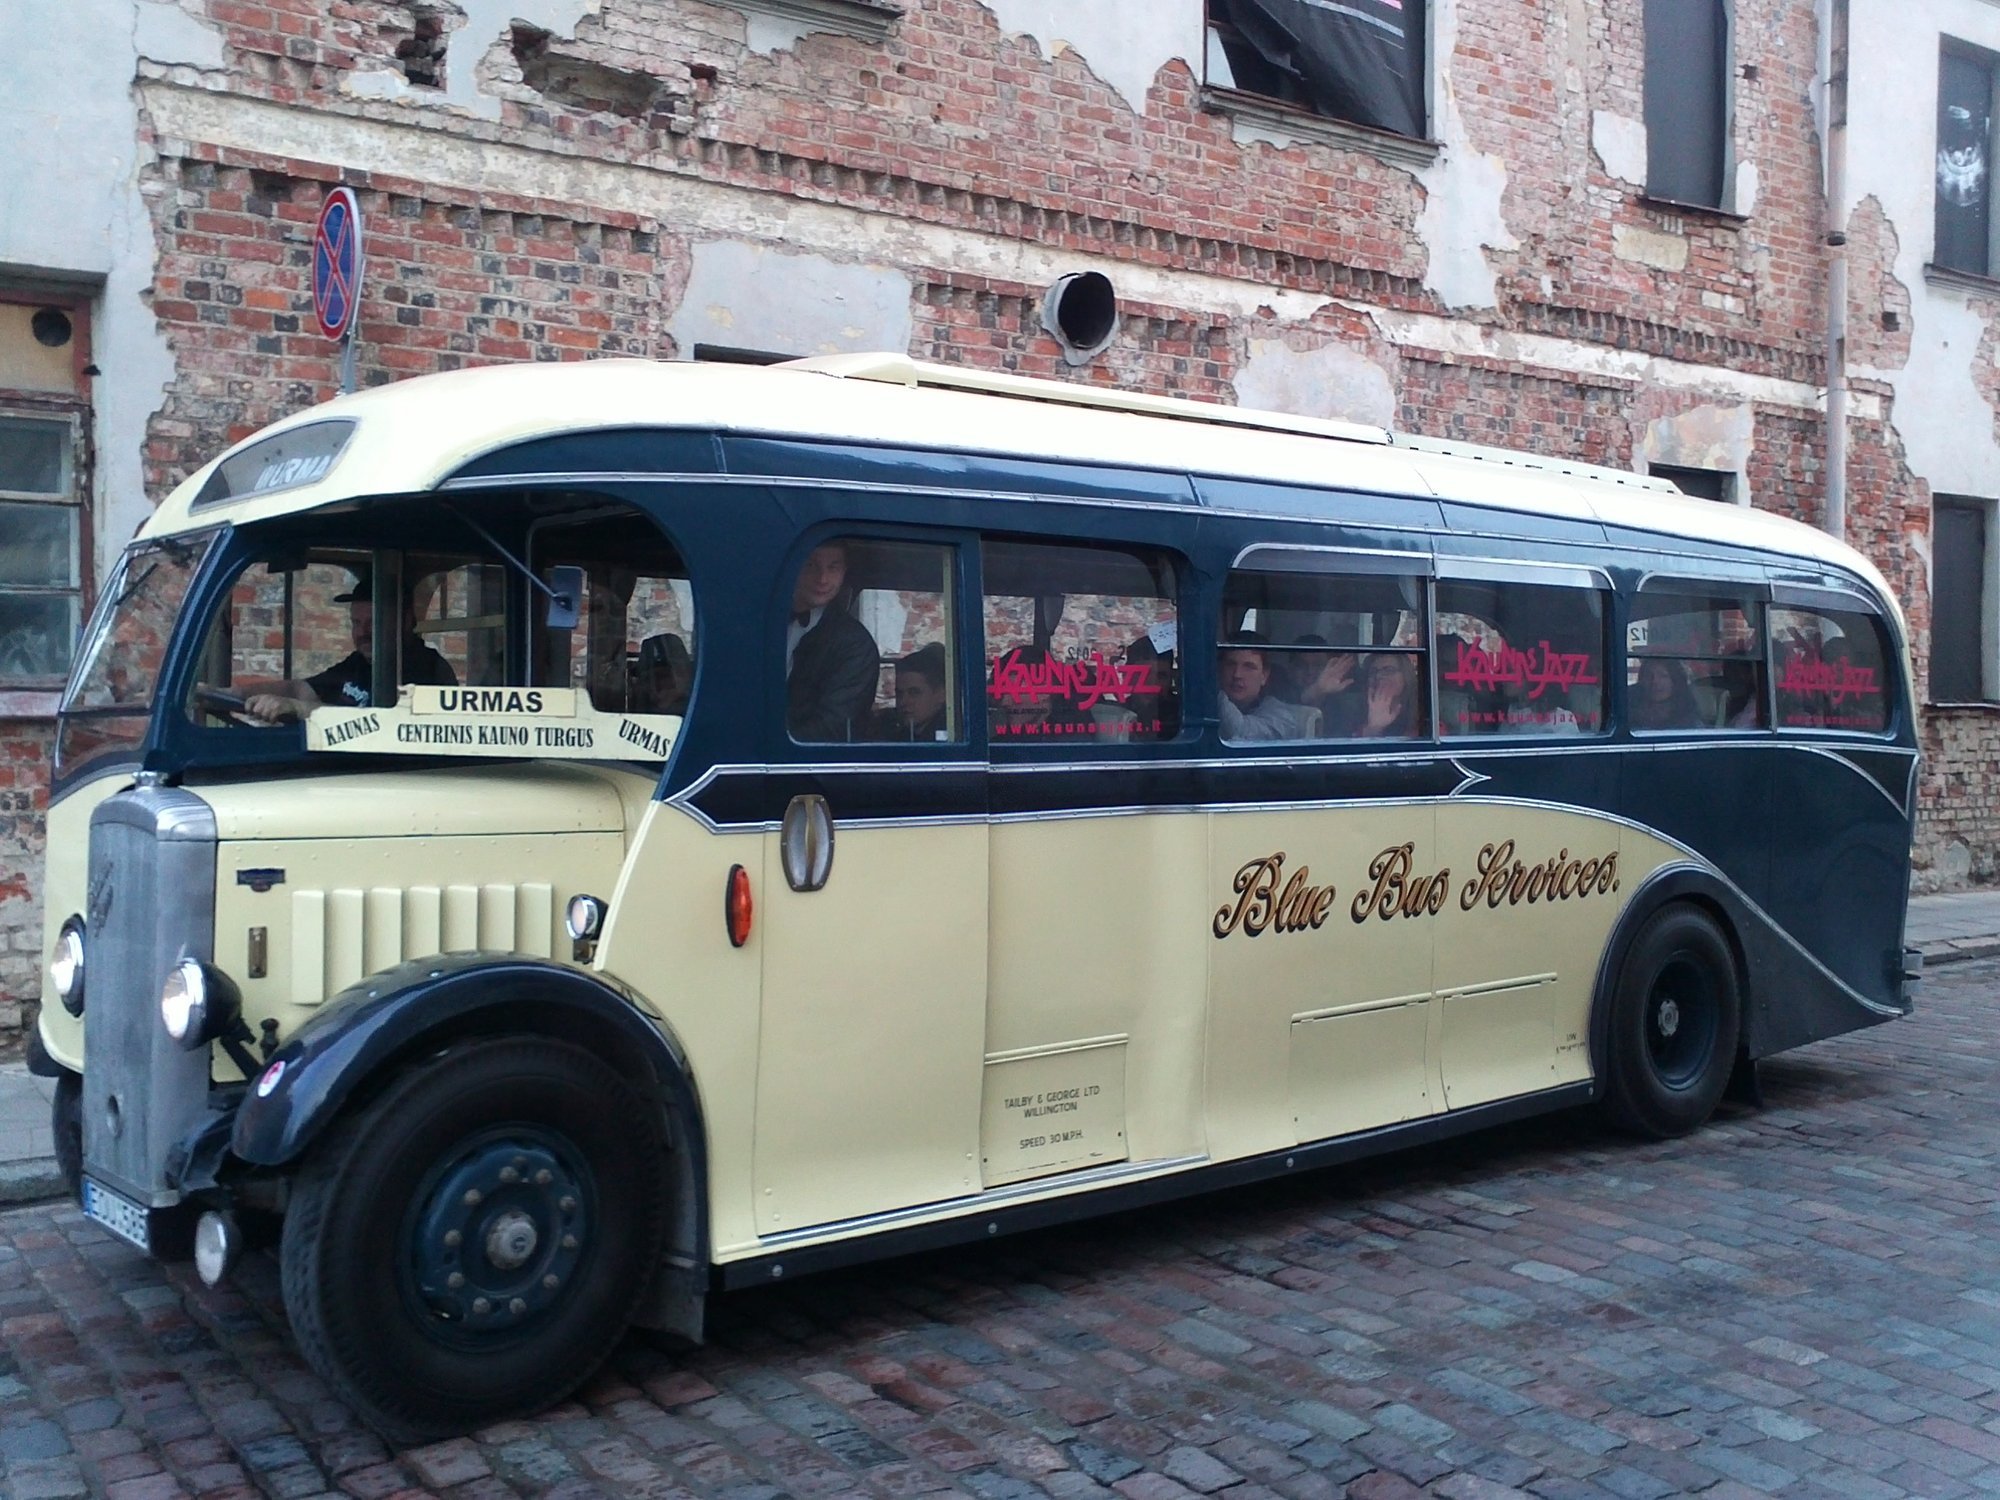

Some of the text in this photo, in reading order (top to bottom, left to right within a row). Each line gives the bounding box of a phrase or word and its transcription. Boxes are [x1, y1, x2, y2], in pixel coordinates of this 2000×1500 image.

[1078, 651, 1161, 711] JAZZ
[1528, 640, 1598, 699] JAZZ
[439, 689, 543, 713] URMAS
[324, 713, 381, 747] KAUNAS
[397, 723, 594, 748] CENTRINIS KAUNO TURGUS
[618, 718, 671, 758] URMAS
[1213, 851, 1337, 939] Blue
[1351, 841, 1450, 924] Bus
[1004, 1095, 1033, 1109] TAILBY
[1046, 1088, 1080, 1103] GEORGE
[1084, 1085, 1101, 1097] LTD
[1024, 1102, 1077, 1118] WILLINGTON
[1020, 1136, 1046, 1149] SPEED
